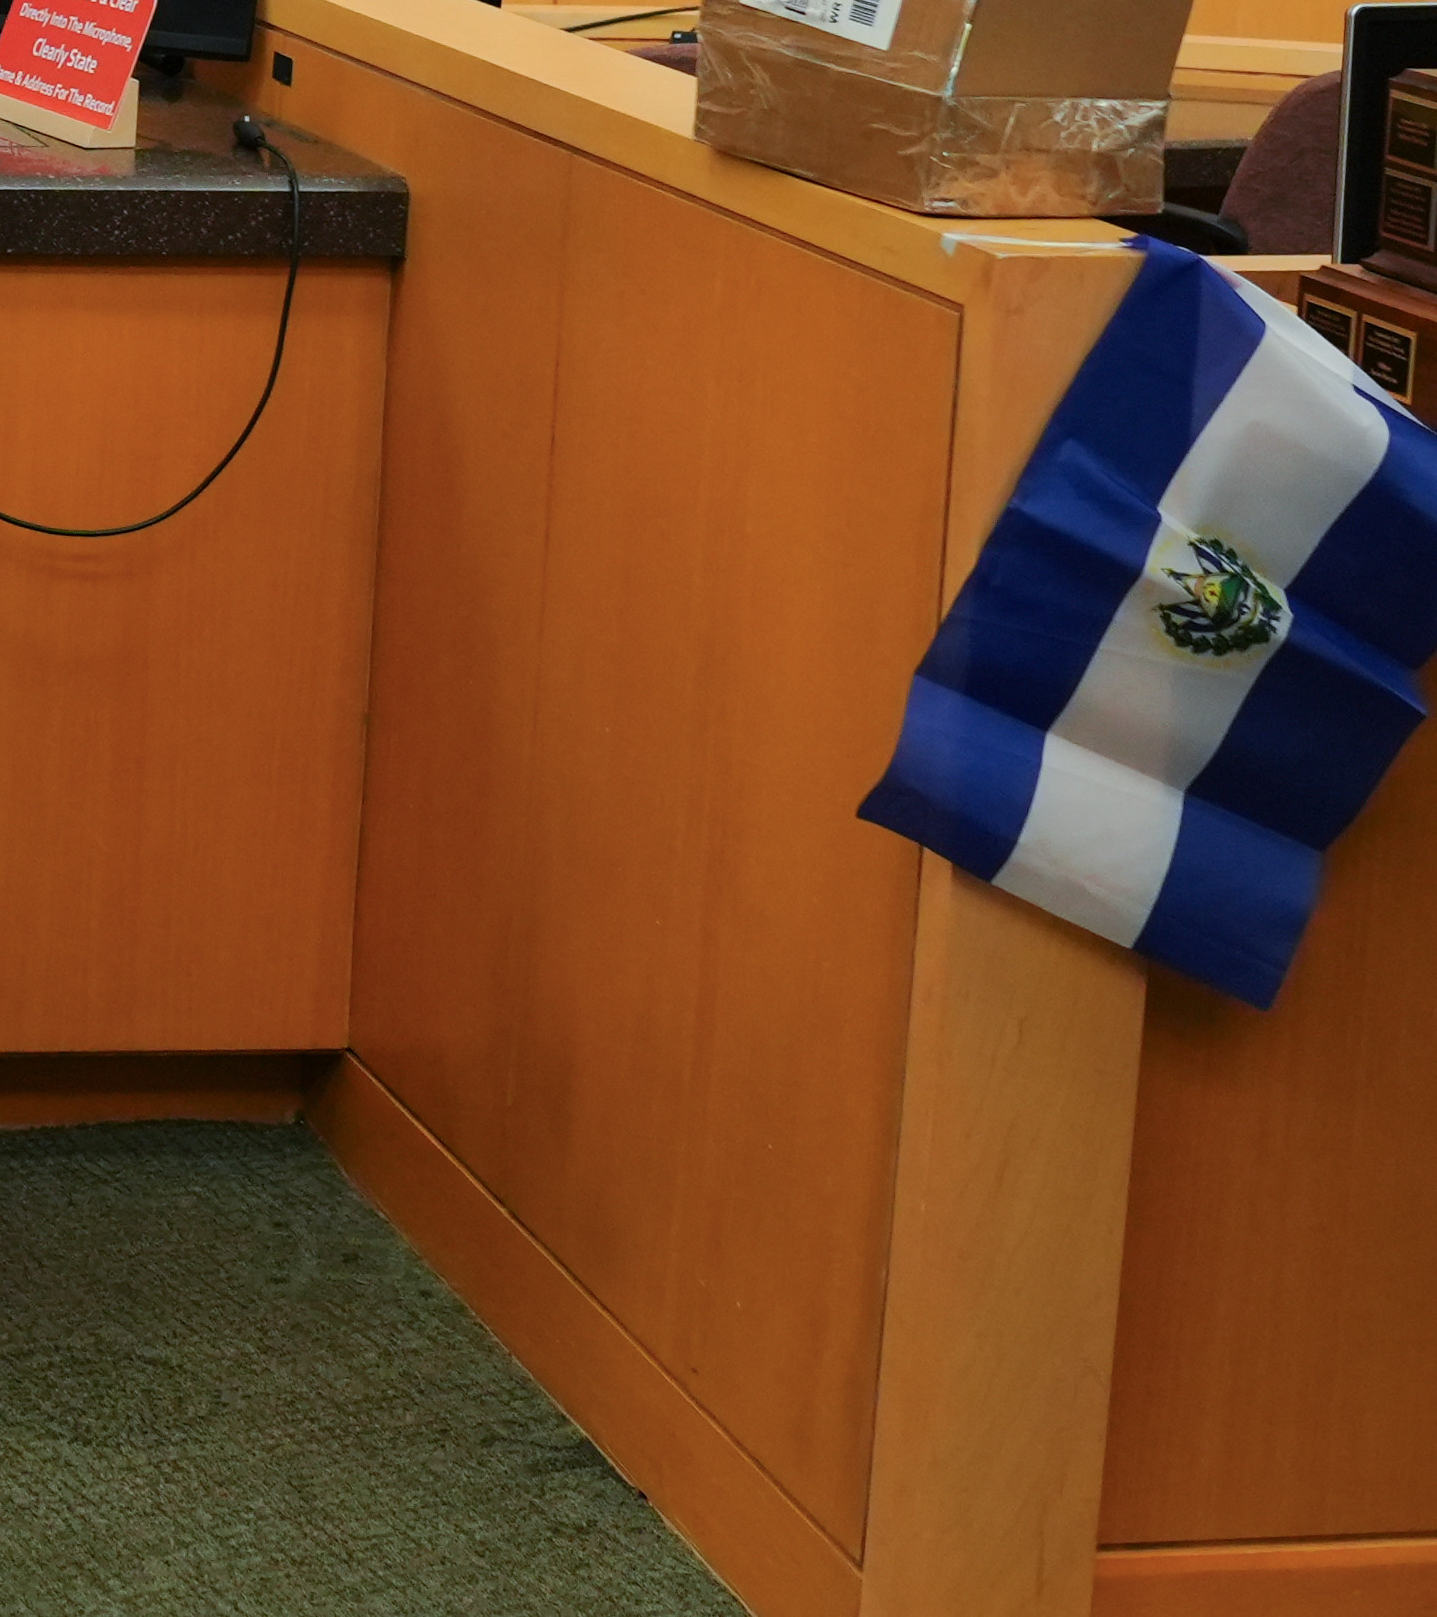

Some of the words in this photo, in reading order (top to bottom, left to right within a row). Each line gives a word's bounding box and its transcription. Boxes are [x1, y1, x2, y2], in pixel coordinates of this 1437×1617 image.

[19, 3, 51, 27] Directly
[50, 12, 67, 28] Into
[67, 17, 83, 33] The
[83, 21, 133, 52] Microphone,
[829, 2, 841, 24] WR
[32, 38, 70, 68] Clearly
[70, 49, 98, 73] State
[15, 71, 23, 85] &
[22, 74, 54, 96] Address
[54, 85, 67, 101] For
[68, 88, 83, 106] The
[83, 94, 114, 116] Record.
